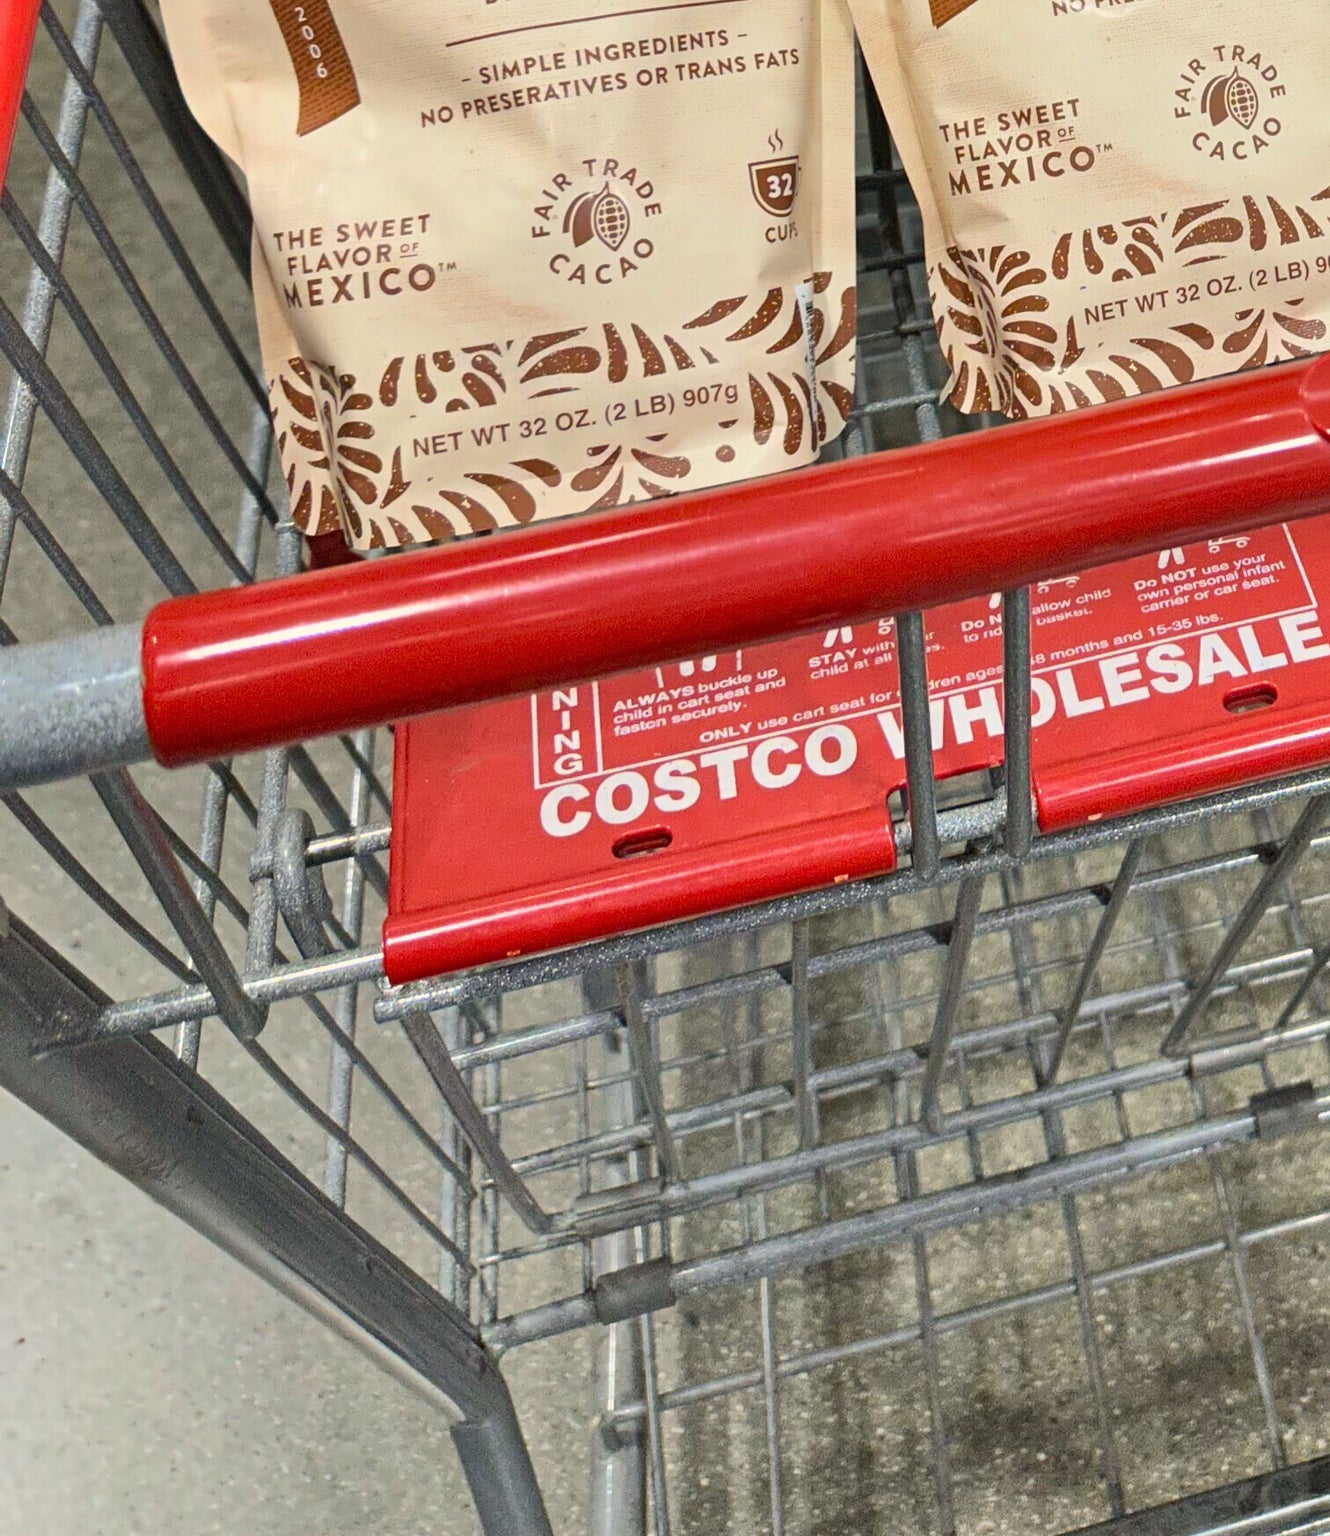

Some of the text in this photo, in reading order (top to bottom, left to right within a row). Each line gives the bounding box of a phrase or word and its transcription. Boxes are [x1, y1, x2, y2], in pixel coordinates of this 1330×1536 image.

[294, 6, 328, 78] 2006
[479, 29, 729, 84] SIMPLE INGREDIENTS
[420, 49, 800, 128] NO PRESERATIVES OR TRANS FATS
[532, 158, 663, 238] FAIR TRADE
[766, 172, 793, 199] 32
[273, 213, 432, 252] THE SWEET
[287, 242, 419, 277] FLAVOR OF
[549, 238, 653, 285] CACAO
[412, 383, 738, 458] NET WT 32 OZ. (2 LB) 907g
[1133, 552, 1266, 592] Do NOT use your
[1137, 560, 1286, 603] own personal infant
[1031, 588, 1113, 616] allow child
[1140, 576, 1280, 614] carrier or car seat.
[809, 640, 895, 667] STAY with
[1050, 611, 1224, 661] months and 15-35 lbs.
[810, 652, 893, 680] child at all
[613, 668, 778, 712] ALWAYS buckle up
[613, 676, 786, 725] child in cart seat and
[551, 687, 584, 776] NING
[671, 702, 748, 726] securely.
[699, 690, 892, 744] ONLY use cart seat for
[540, 724, 858, 837] COSTCO
